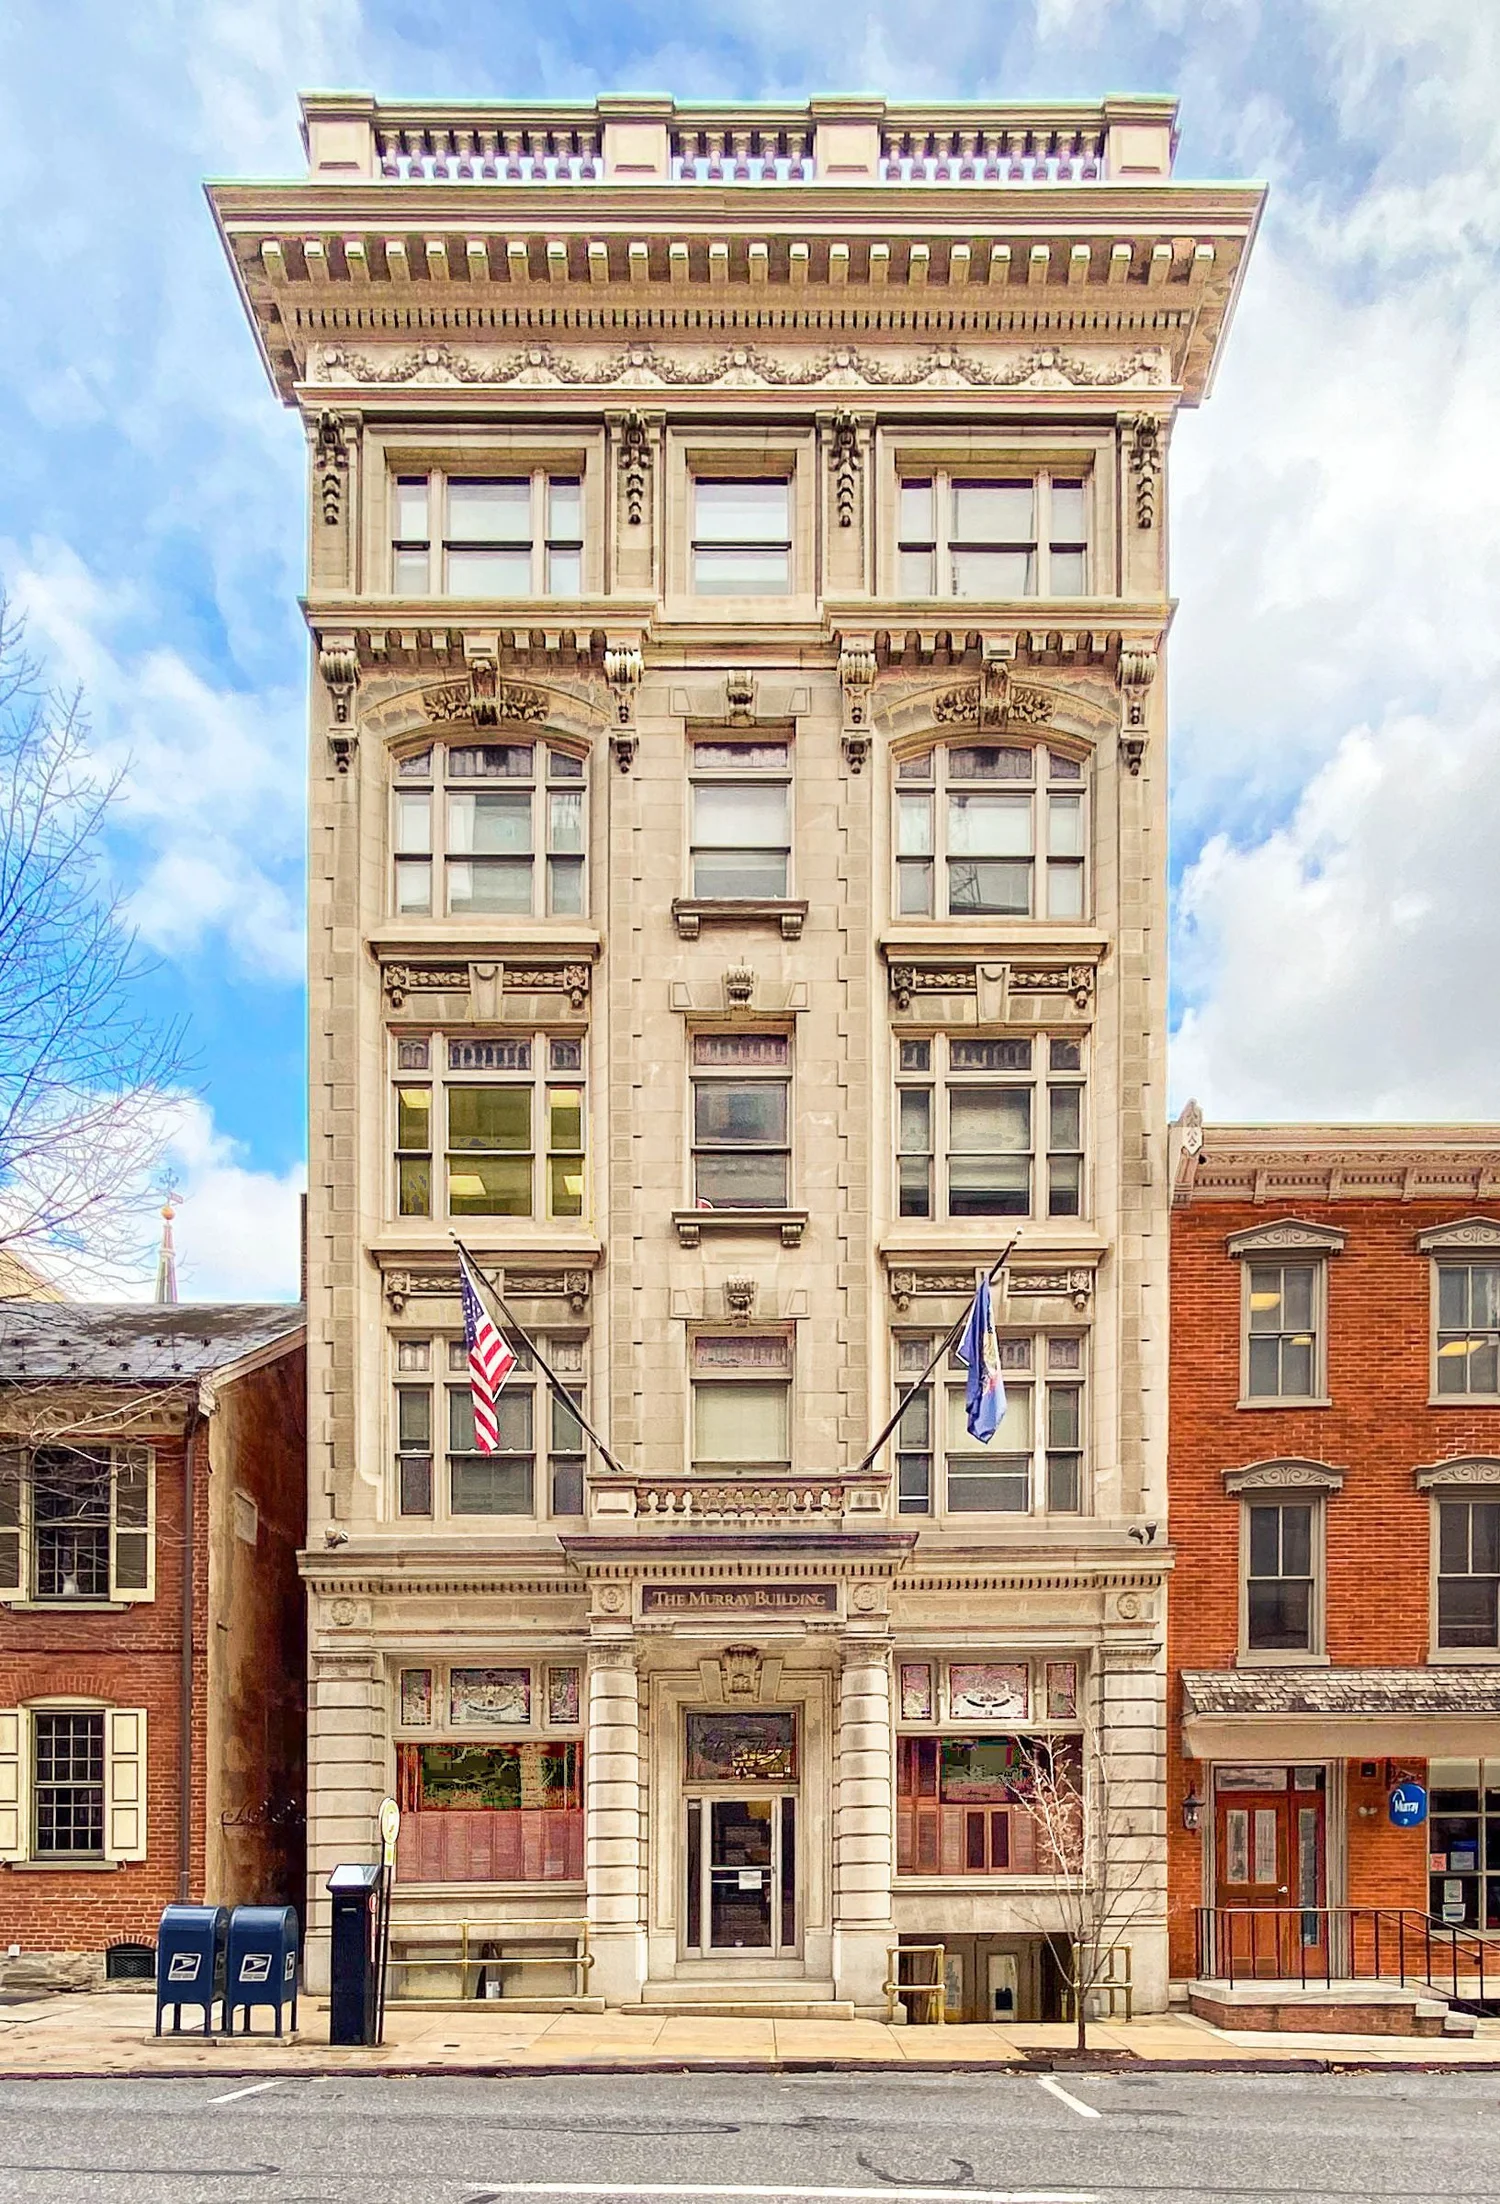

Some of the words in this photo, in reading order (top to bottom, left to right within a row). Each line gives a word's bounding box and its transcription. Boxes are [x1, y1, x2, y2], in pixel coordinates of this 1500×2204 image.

[652, 1591, 686, 1606] THE
[689, 1591, 751, 1606] MURRAY
[755, 1590, 826, 1606] BUILDING
[1394, 1799, 1419, 1815] Murray
